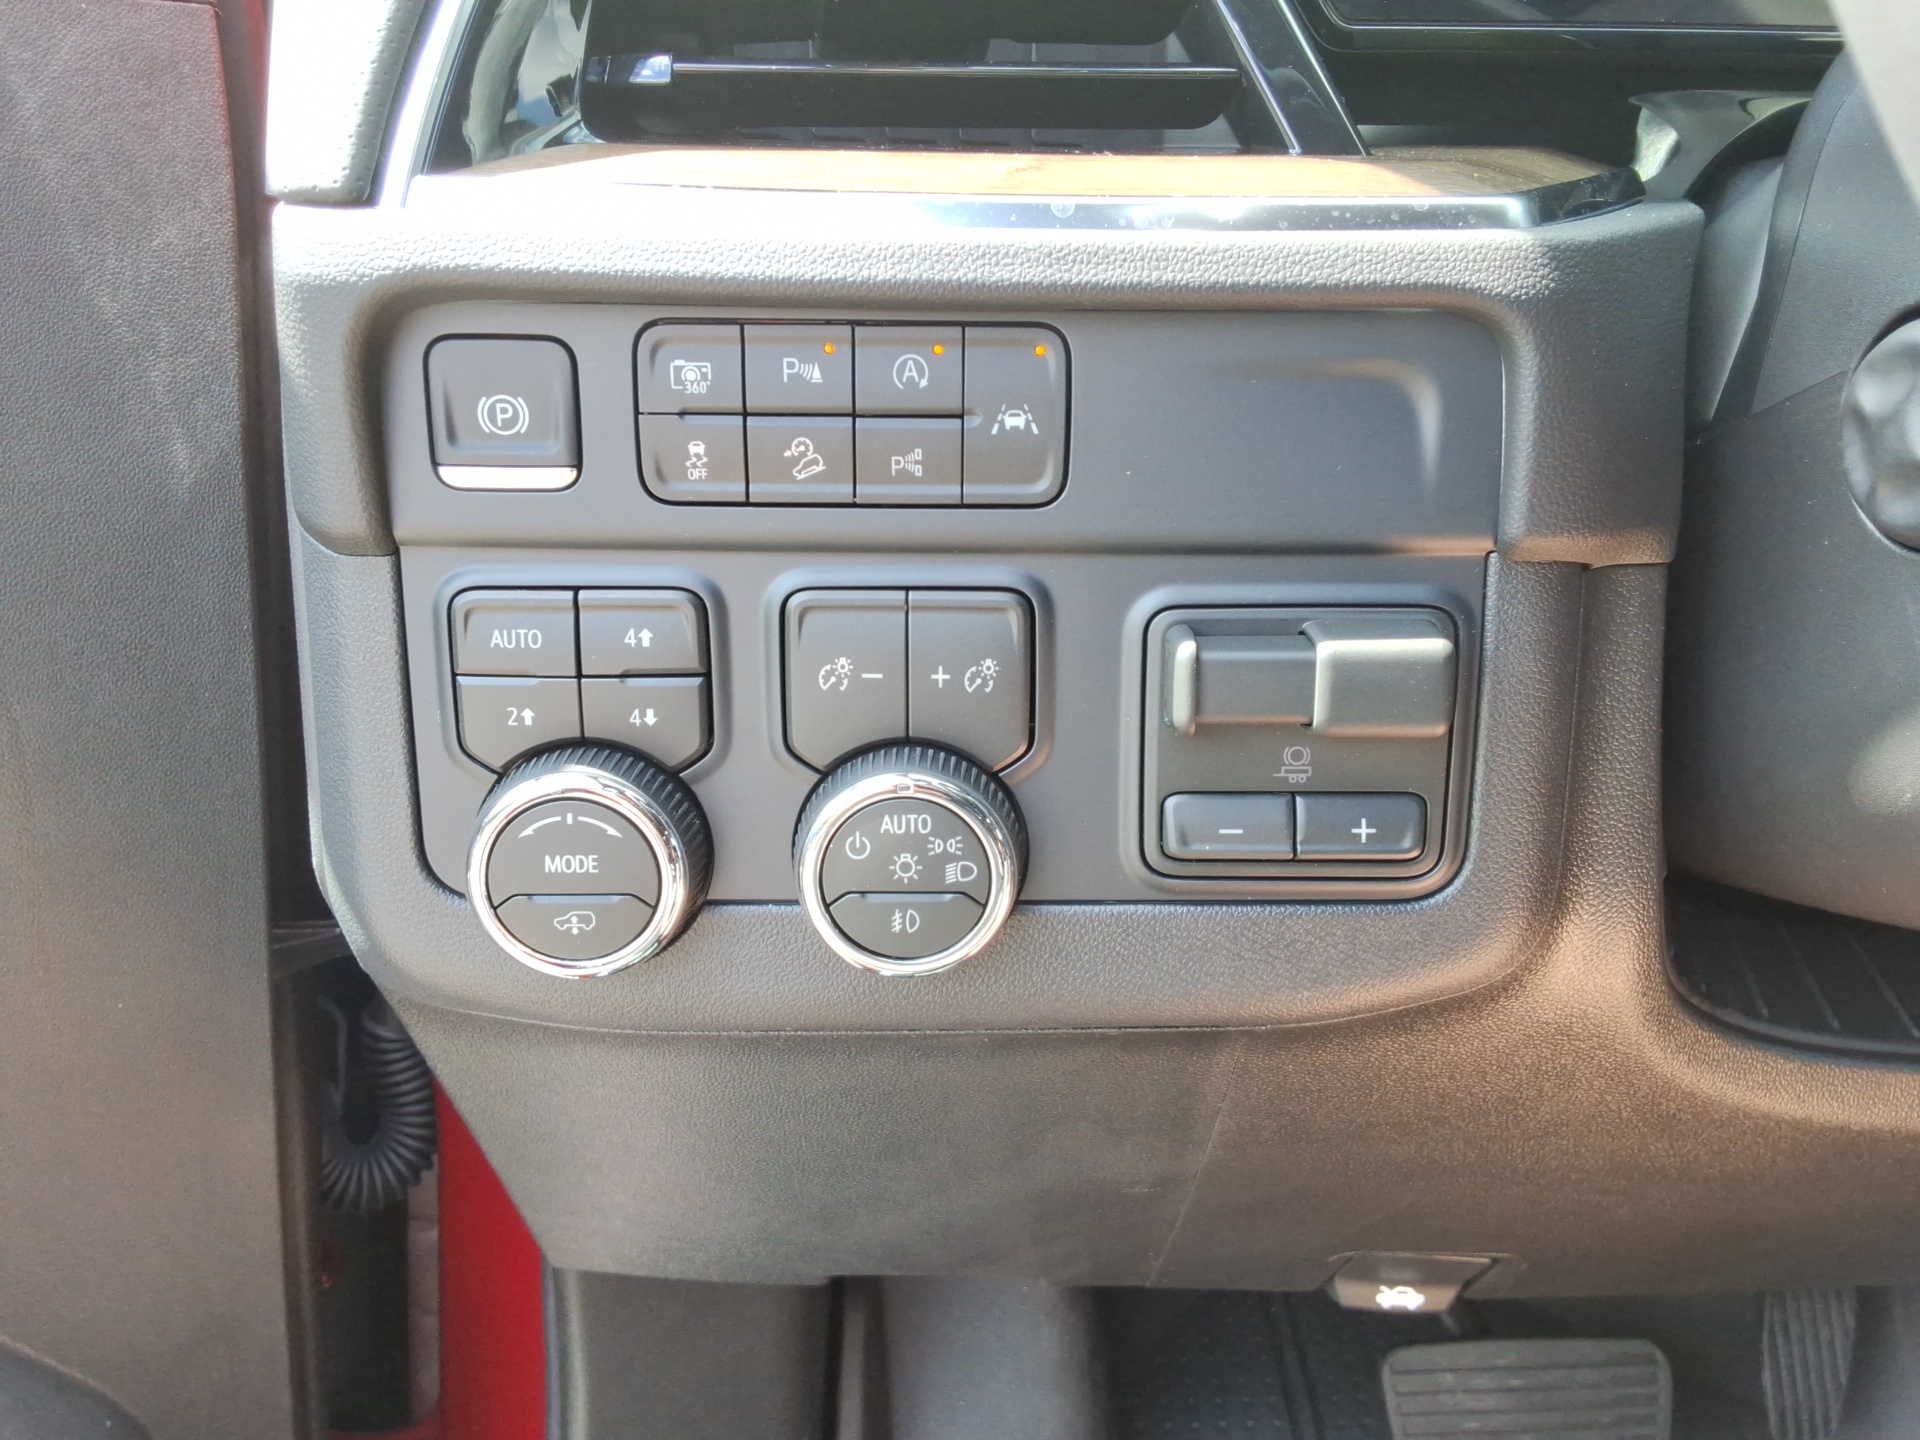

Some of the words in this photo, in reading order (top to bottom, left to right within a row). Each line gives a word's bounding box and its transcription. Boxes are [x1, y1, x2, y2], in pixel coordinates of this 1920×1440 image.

[782, 358, 799, 383] P
[902, 360, 919, 382] A
[687, 468, 708, 480] OFF
[490, 629, 542, 648] AUTO
[624, 629, 637, 647] 4
[507, 708, 518, 725] 2
[629, 709, 642, 726] 4
[880, 814, 932, 834] AUTO
[544, 855, 599, 873] MODE
